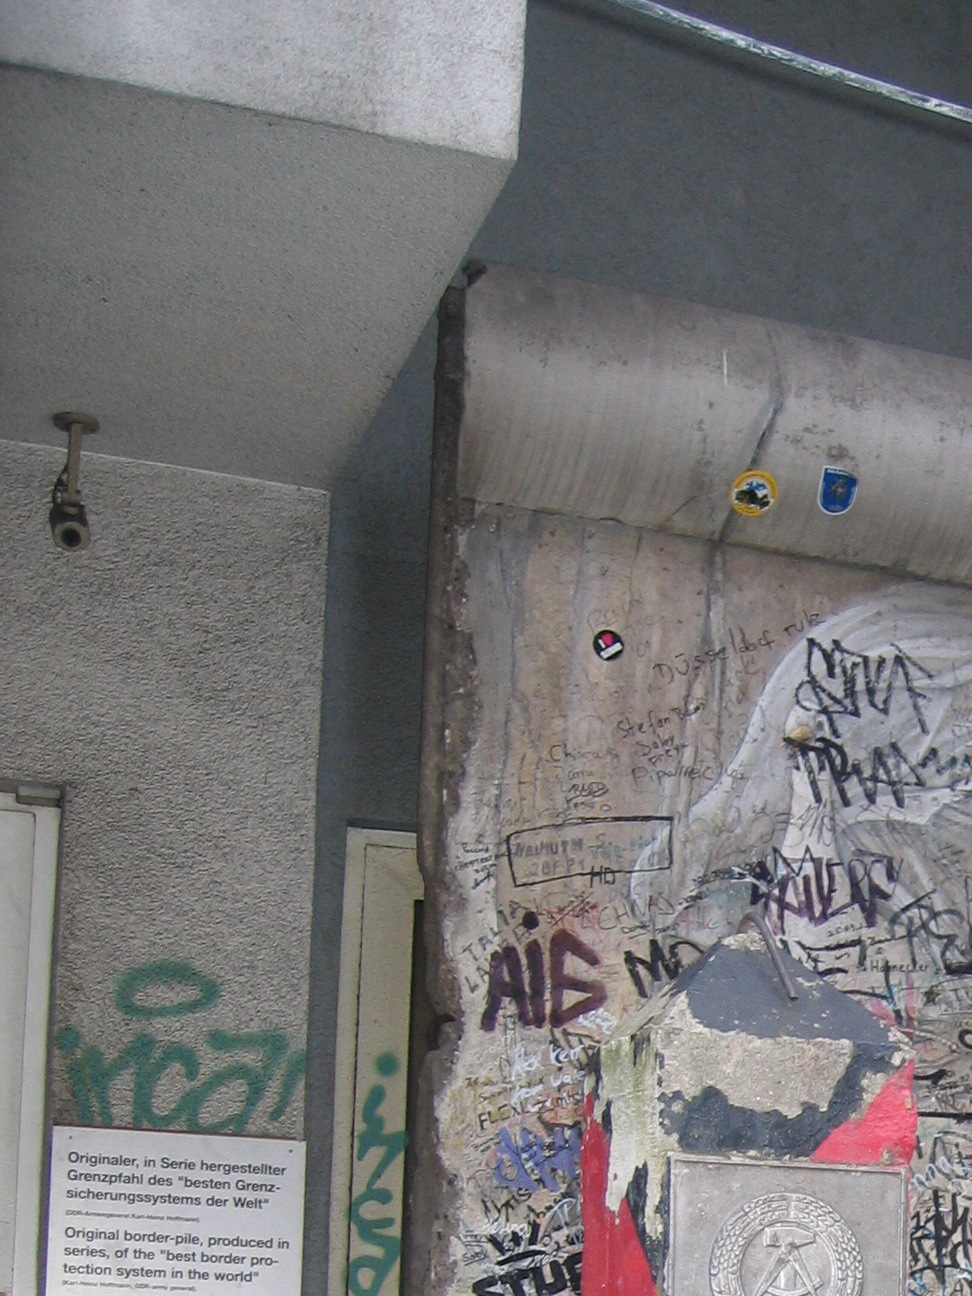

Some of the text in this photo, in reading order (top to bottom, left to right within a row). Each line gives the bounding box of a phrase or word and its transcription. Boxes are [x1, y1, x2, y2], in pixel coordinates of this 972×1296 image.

[67, 1151, 286, 1176] Originaler, in Serie hergestellter
[66, 1168, 281, 1192] Grenzpfahl des "besten Grenz-
[65, 1185, 269, 1208] sicherungssystems der Welt"
[64, 1225, 289, 1249] Original border-pile, produced in
[63, 1244, 278, 1268] series, of the "best border pro-
[62, 1262, 259, 1282] tection system in the world"
